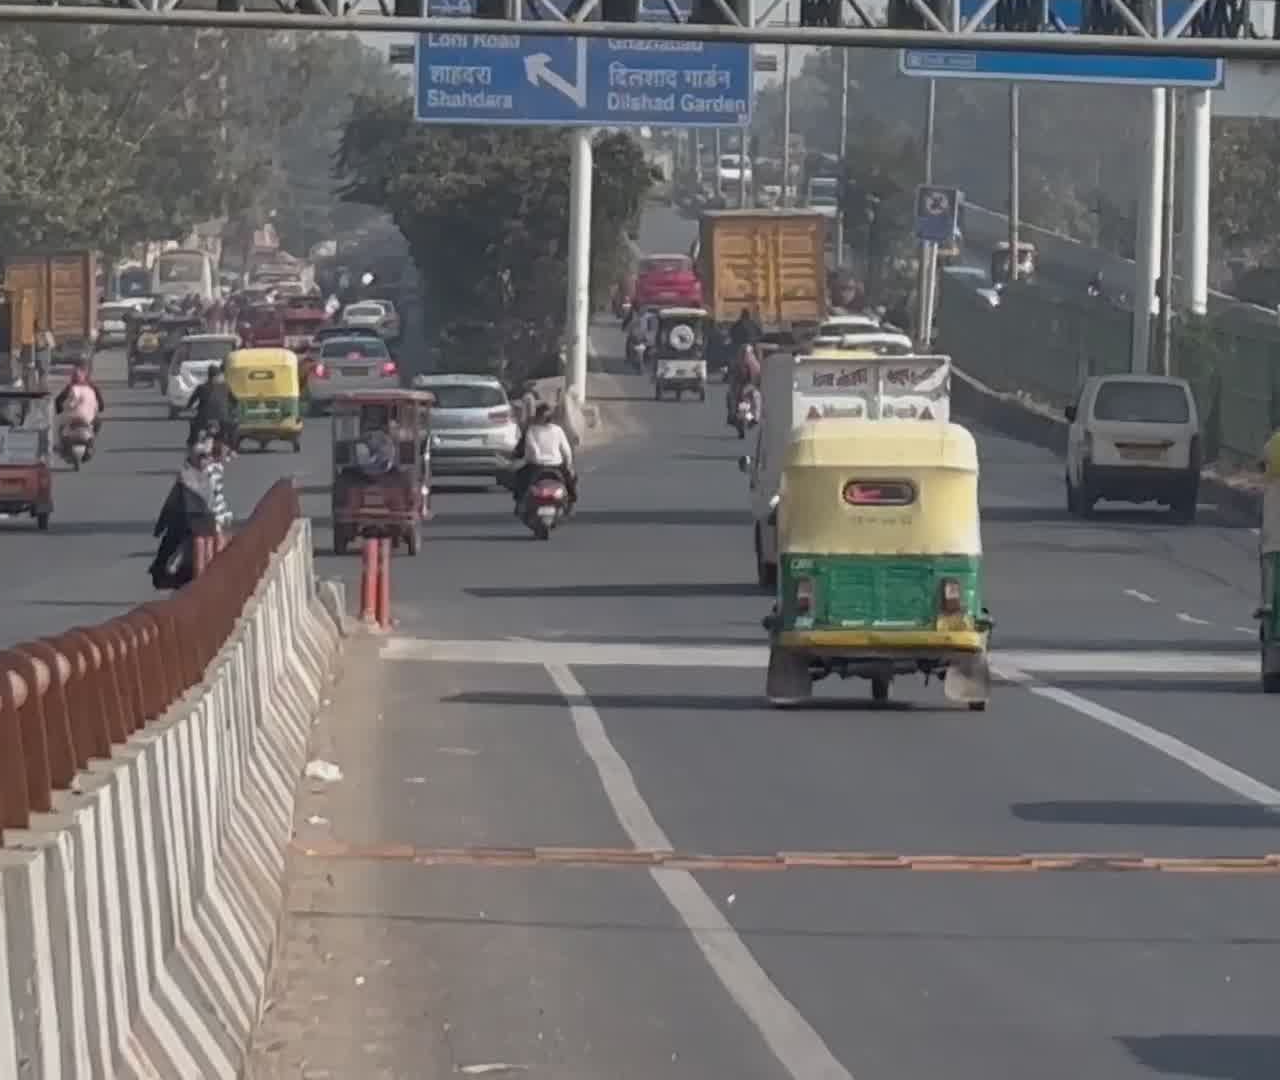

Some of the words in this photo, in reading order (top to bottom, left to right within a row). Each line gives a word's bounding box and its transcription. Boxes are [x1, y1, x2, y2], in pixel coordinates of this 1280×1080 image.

[427, 89, 512, 109] Shahdara
[607, 92, 675, 111] Dilshad
[680, 94, 747, 113] Garden
